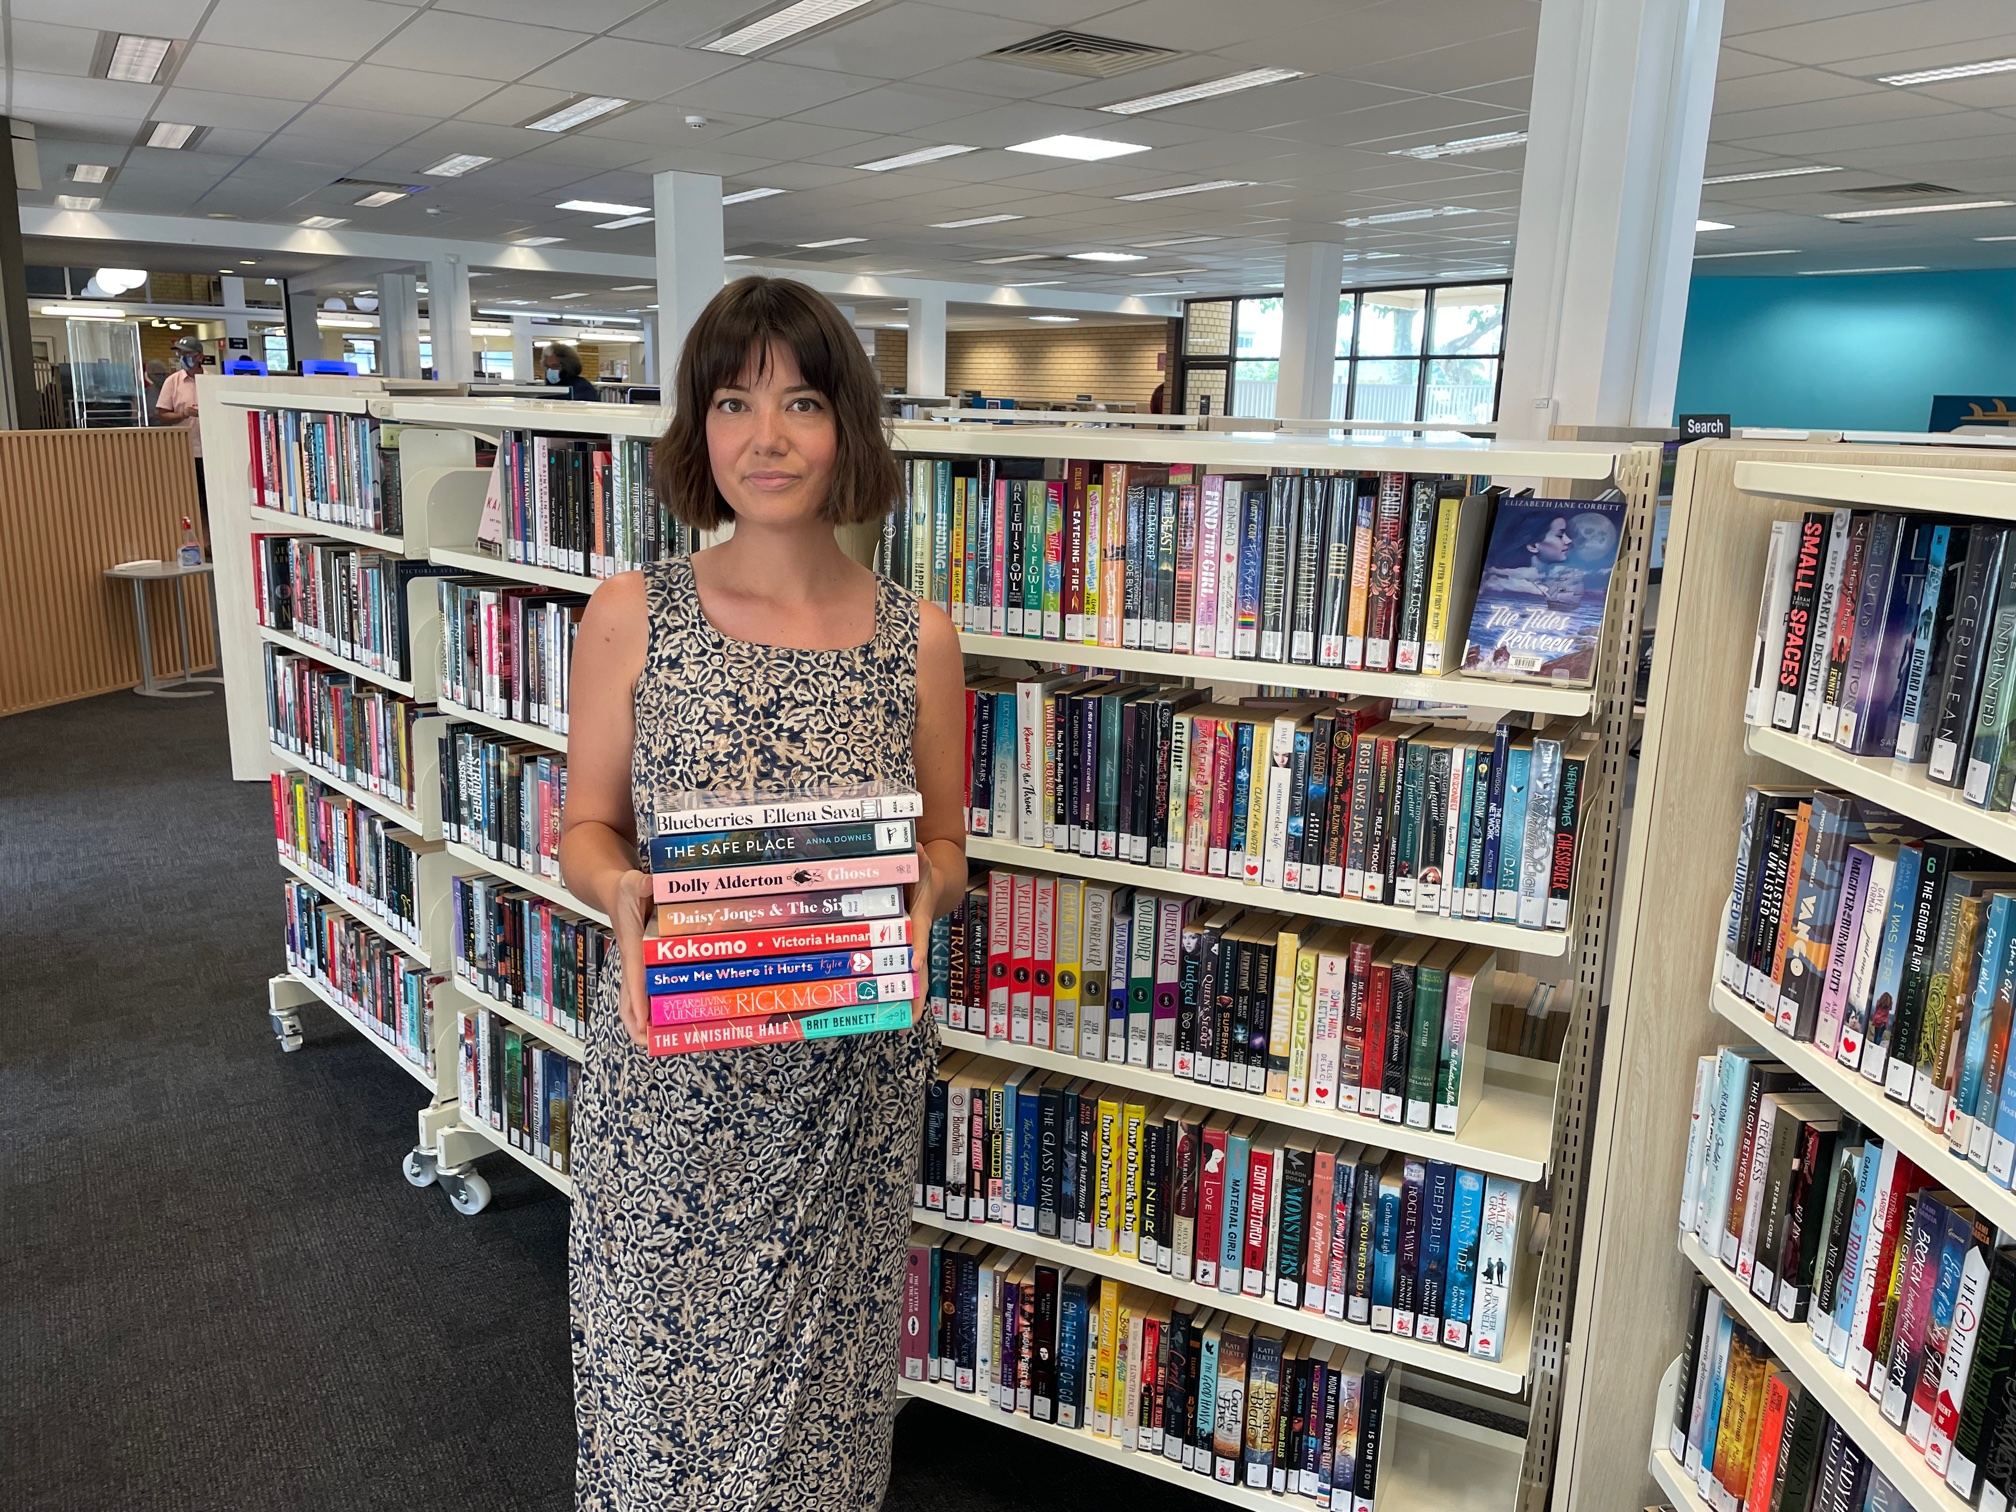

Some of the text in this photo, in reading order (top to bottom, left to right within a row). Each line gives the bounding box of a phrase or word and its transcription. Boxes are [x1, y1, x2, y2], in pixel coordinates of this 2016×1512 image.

[1688, 419, 1723, 433] Search
[633, 510, 641, 533] SHOCK
[1225, 498, 1236, 545] CONRAD
[1505, 500, 1552, 508] ELIZABETH
[1578, 502, 1621, 511] CORBETT
[935, 512, 947, 569] FINDING
[1010, 483, 1022, 591] ARTEMIS FOWL
[1028, 486, 1040, 593] ARTEMIS FOWL
[1072, 511, 1080, 563] CATCHING
[1201, 490, 1219, 597] FIND THE GIRL
[1328, 543, 1347, 580] GUILE
[1352, 531, 1369, 590] CHANGERS
[1071, 568, 1079, 591] FIRE
[1125, 579, 1133, 610] BLYTHE
[1780, 522, 1822, 687] SMALL SPACES
[1486, 605, 1570, 631] The Tides
[1495, 628, 1574, 653] Between
[1807, 583, 1834, 695] SPARTAN DESTINY
[1903, 648, 1926, 718] RICHARD PAUL
[1939, 595, 1978, 741] CERULEAN
[1981, 612, 2015, 727] UNDAUNTED
[1161, 708, 1169, 728] CROSS
[1172, 722, 1185, 771] arthur
[458, 760, 467, 801] ASCENSION
[1045, 704, 1054, 796] WAITING FOR GONZO
[1193, 726, 1208, 819] TAKE THREE GIRLS
[1313, 742, 1326, 785] SOVEREIGN
[471, 757, 483, 822] STRONGER
[1234, 784, 1247, 840] DARK MOON
[1352, 743, 1371, 844] ROSIE LOVES JACK
[1393, 757, 1404, 815] CRANK PALACE
[657, 812, 754, 832] Blueberries
[763, 807, 817, 824] Ellena
[665, 834, 872, 858] THE SAFE PLACE ANNA DOWNES
[1468, 781, 1487, 875] JACKDAW RANDOMS
[1552, 765, 1578, 890] STEPHEN DAVIES CHESSBOXER
[668, 867, 880, 894] Dolly Alderton Ghosts
[1759, 851, 1777, 916] UNLISTED
[1769, 860, 1787, 924] UNLISTED
[667, 909, 720, 926] Daisy
[720, 906, 765, 923] Jones
[769, 904, 783, 916] &
[787, 901, 818, 915] The
[992, 880, 1009, 946] SPELLSLINGER
[1014, 883, 1031, 951] SPELLSLINGER
[1038, 888, 1051, 954] WAY ARGOSI
[1060, 884, 1077, 960] CHARMCASTER
[1085, 893, 1104, 966] CROWNBREAKER
[1135, 899, 1153, 962] SOULBINDER
[1160, 904, 1180, 966] QUEENSLAYER
[1790, 895, 1816, 977] VANGO
[1829, 857, 1863, 996] DAUGHTER BURNING CITY
[654, 959, 842, 985] Show Me Where it Hurts Kylie
[657, 939, 746, 960] Kokomo
[772, 935, 822, 948] Victoria
[1112, 922, 1127, 983] SHADOWBLACK
[670, 999, 694, 1009] YEAR
[700, 995, 732, 1006] LIVING
[736, 989, 787, 1014] RICK
[792, 982, 857, 1008] MORT
[1180, 955, 1198, 1005] Judged
[654, 1013, 876, 1048] THE VANISHING HALF BRIT BENNETT
[663, 1006, 730, 1020] VULNERABLY
[1200, 974, 1213, 1049] QUEEN'S SECRET
[1328, 990, 1340, 1039] SOMETHING
[1421, 1020, 1429, 1048] SLITHER
[1449, 986, 1466, 1045] kaz delaney
[1346, 1025, 1362, 1080] STOLEN
[992, 1092, 1002, 1178] WEIRDOS QUIMBOIDS
[1042, 1107, 1055, 1172] THE GLASS
[1735, 1081, 1760, 1202] THIS LIGHT BETWEEN US
[1752, 1119, 1771, 1184] RECKLESS
[1227, 1179, 1239, 1261] MATERIAL GIRLS
[1249, 1165, 1267, 1248] CORY DOCTOROW
[1280, 1184, 1303, 1278] MONSTERS
[1403, 1185, 1418, 1261] ROGUE WAVE
[1429, 1175, 1446, 1253] DEEP BLUE
[1456, 1196, 1472, 1272] DARK TIDE
[1485, 1196, 1498, 1236] GRAVES
[1494, 1192, 1508, 1244] SHALLOW
[1840, 1156, 1871, 1297] GANTOS TROUBLE
[1820, 1243, 1839, 1310] NEIL GAIMAN
[1893, 1204, 1917, 1297] KAMI GARCIA
[1909, 1228, 1931, 1286] BROKEN
[1946, 1329, 1967, 1379] FILES
[1247, 1392, 1262, 1434] Blade
[1260, 1390, 1276, 1445] Poisoned
